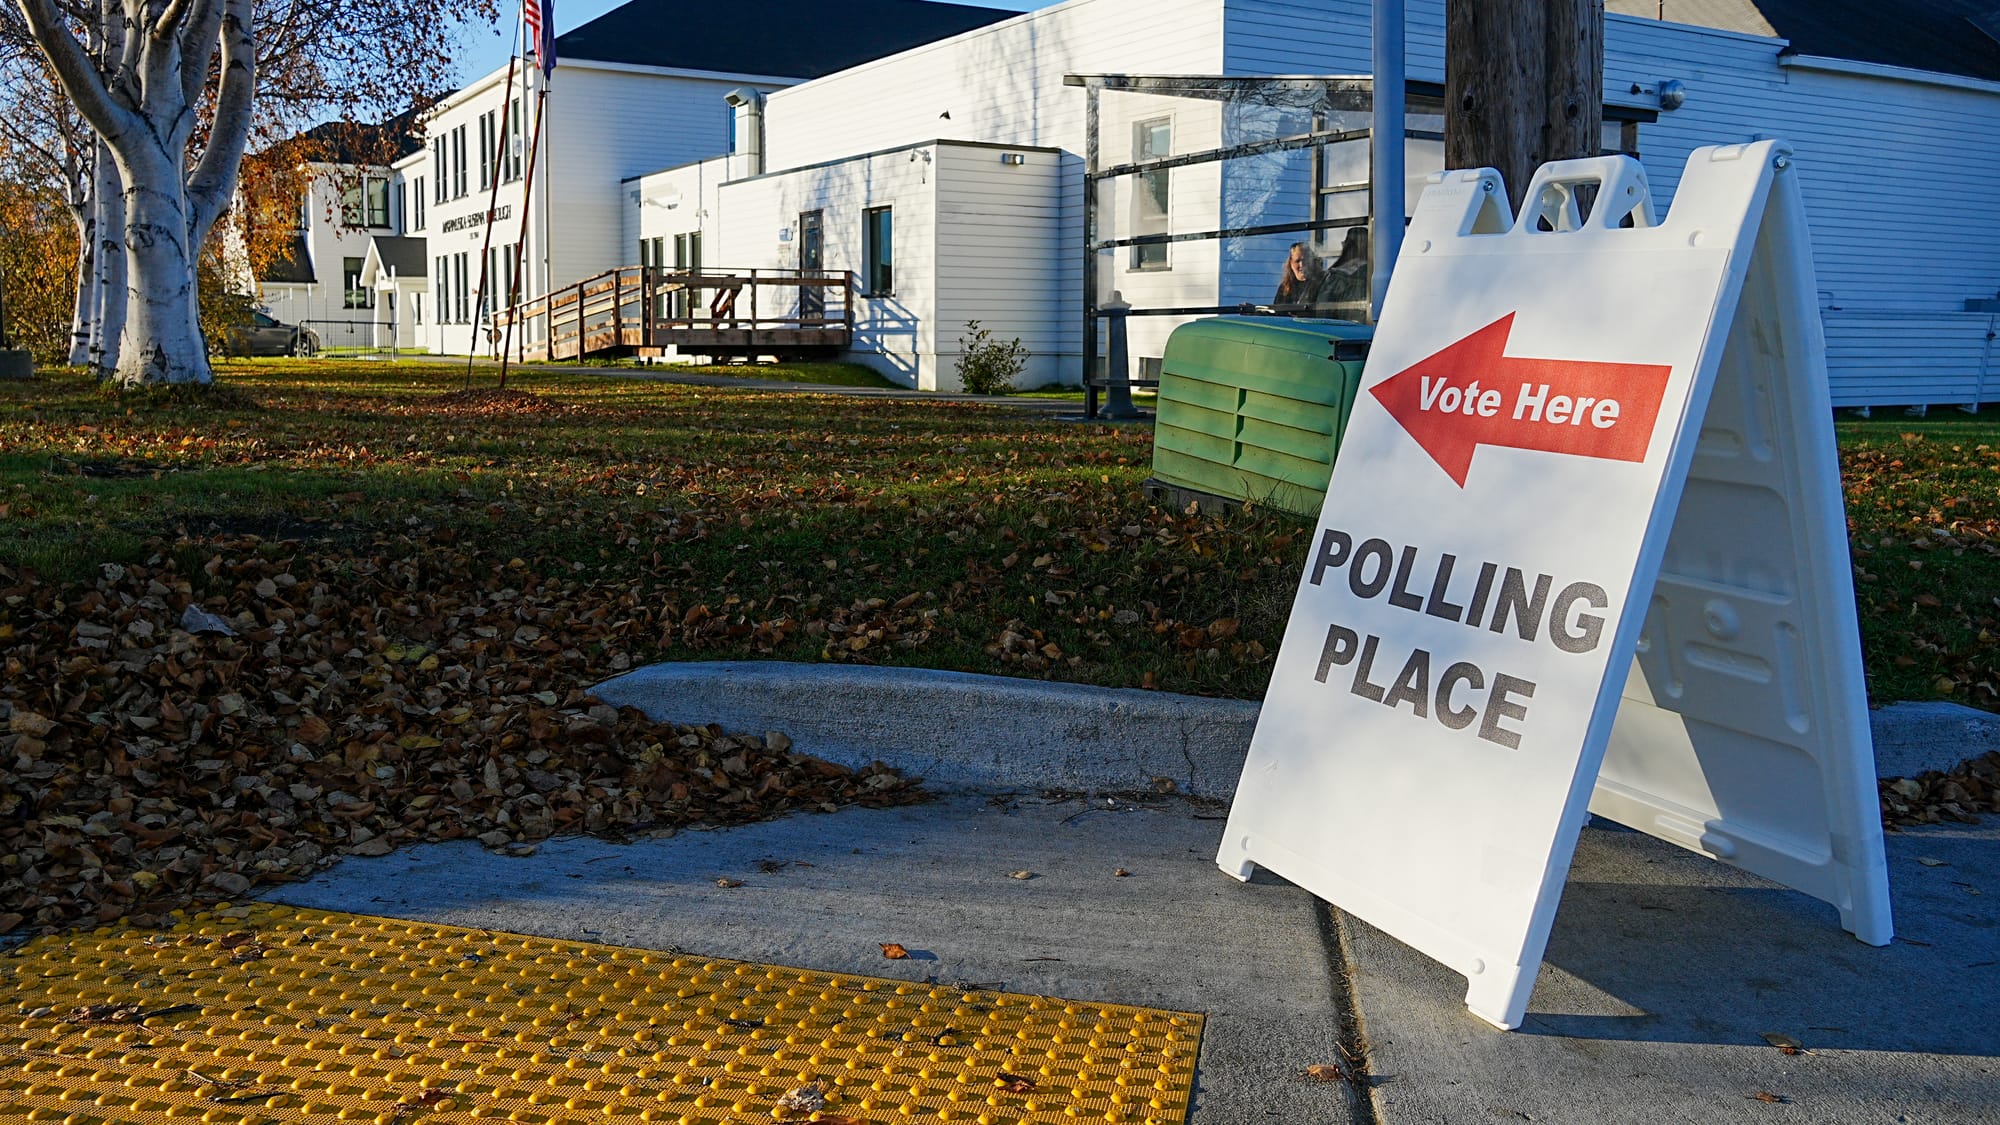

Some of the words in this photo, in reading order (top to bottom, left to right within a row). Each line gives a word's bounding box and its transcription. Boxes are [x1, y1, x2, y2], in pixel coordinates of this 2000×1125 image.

[1419, 375, 1501, 417] Vote
[1512, 382, 1620, 429] Here
[1309, 528, 1608, 654] POLLING
[1314, 623, 1536, 750] PLACE
